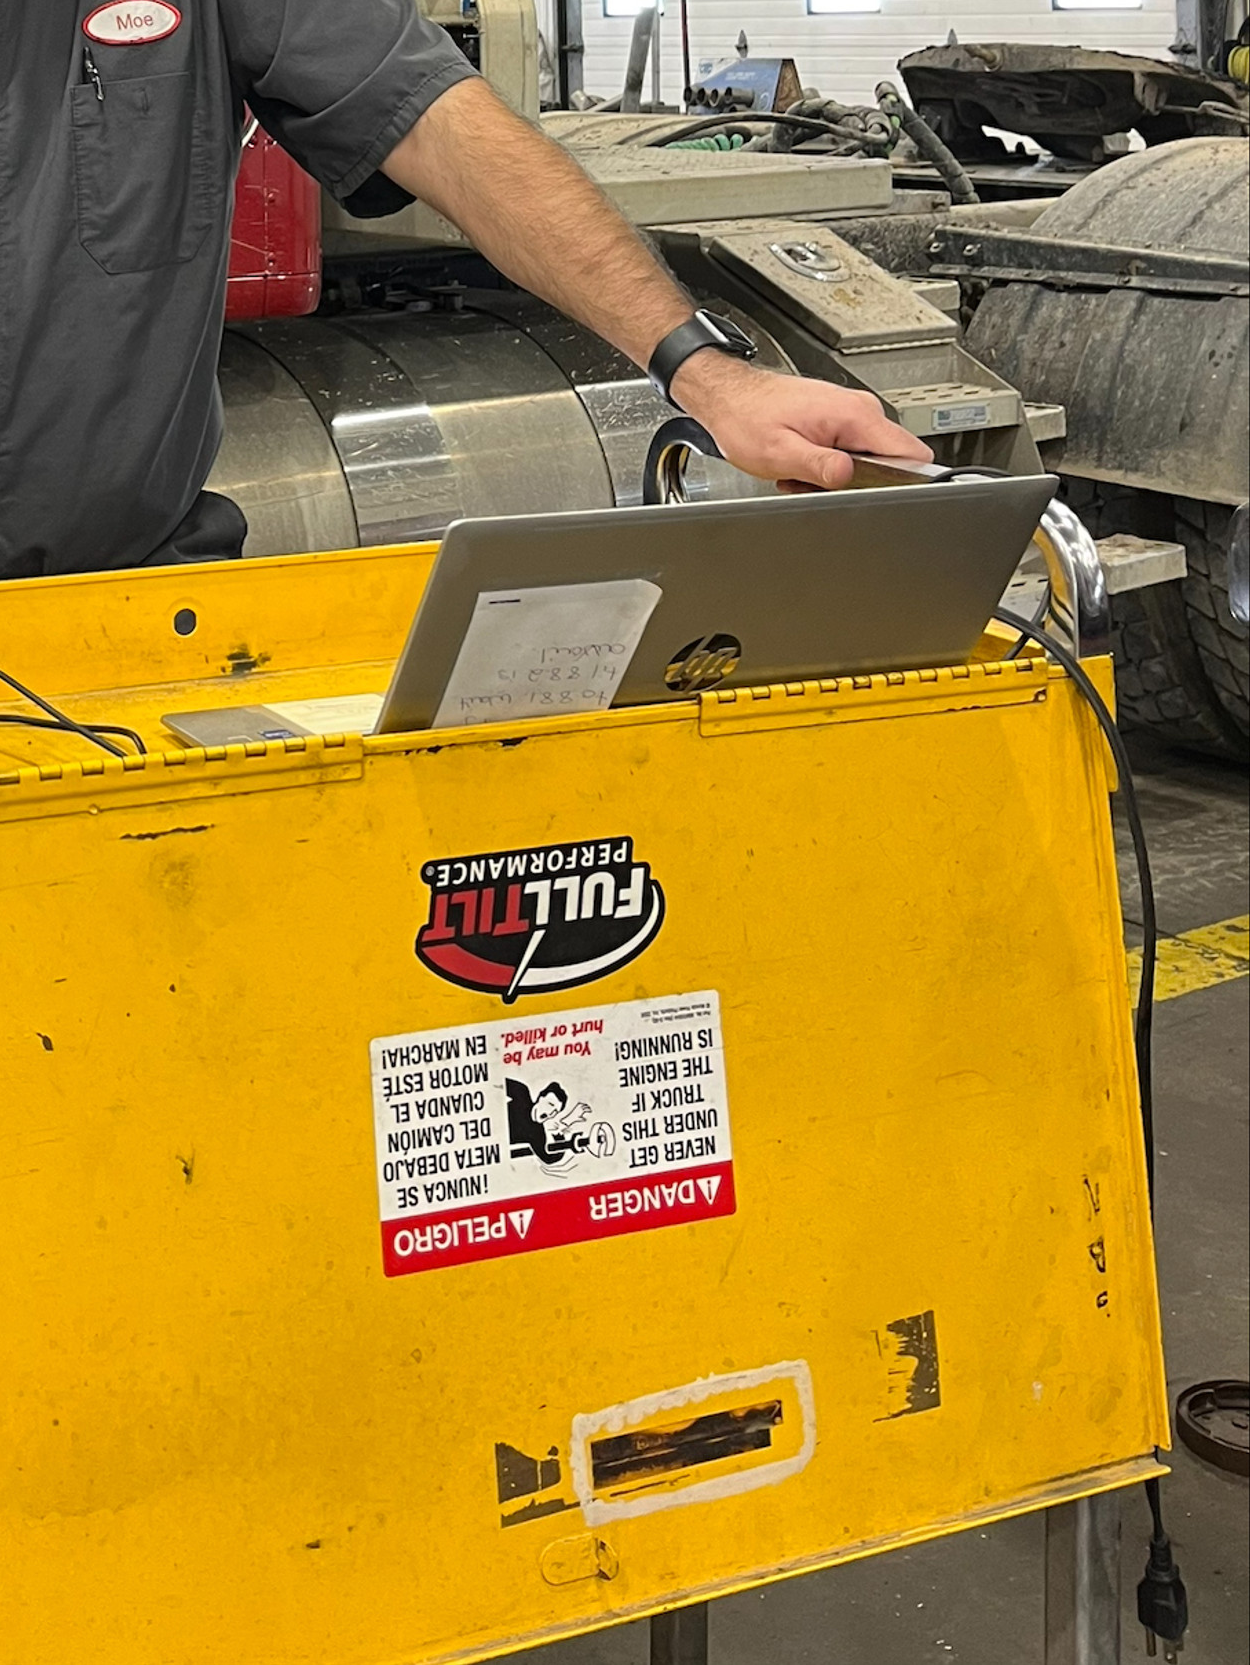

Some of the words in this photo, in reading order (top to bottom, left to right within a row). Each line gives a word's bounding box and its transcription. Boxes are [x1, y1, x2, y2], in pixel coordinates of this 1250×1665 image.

[116, 13, 154, 31] Moe
[501, 1027, 548, 1046] killed.
[551, 1024, 568, 1039] or
[571, 1020, 604, 1036] hurt
[698, 1028, 713, 1048] IS
[382, 1039, 460, 1069] MARCHA!
[465, 1035, 487, 1057] EN
[503, 1048, 523, 1066] be
[526, 1043, 560, 1063] may
[564, 1041, 591, 1058] You
[615, 1031, 693, 1061] RUNNING!
[429, 1062, 488, 1089] MOTOR
[619, 1061, 677, 1087] ENGINE
[682, 1056, 713, 1077] THE
[382, 1072, 424, 1097] ESTÉ
[415, 1091, 484, 1119] CUANDA
[632, 1093, 646, 1113] IF
[650, 1084, 705, 1110] TRUCK
[390, 1102, 410, 1123] EL
[663, 1109, 718, 1134] UNDER
[388, 1124, 454, 1155] CAMIÓN
[459, 1118, 491, 1140] DEL
[622, 1118, 659, 1142] THIS
[454, 1144, 500, 1169] META
[629, 1145, 658, 1168] GET
[664, 1135, 716, 1161] NEVER
[383, 1151, 449, 1182] DEBAJO
[397, 1186, 418, 1208] SE
[589, 1179, 695, 1220] DANGER
[394, 1213, 506, 1256] PELIGRO
